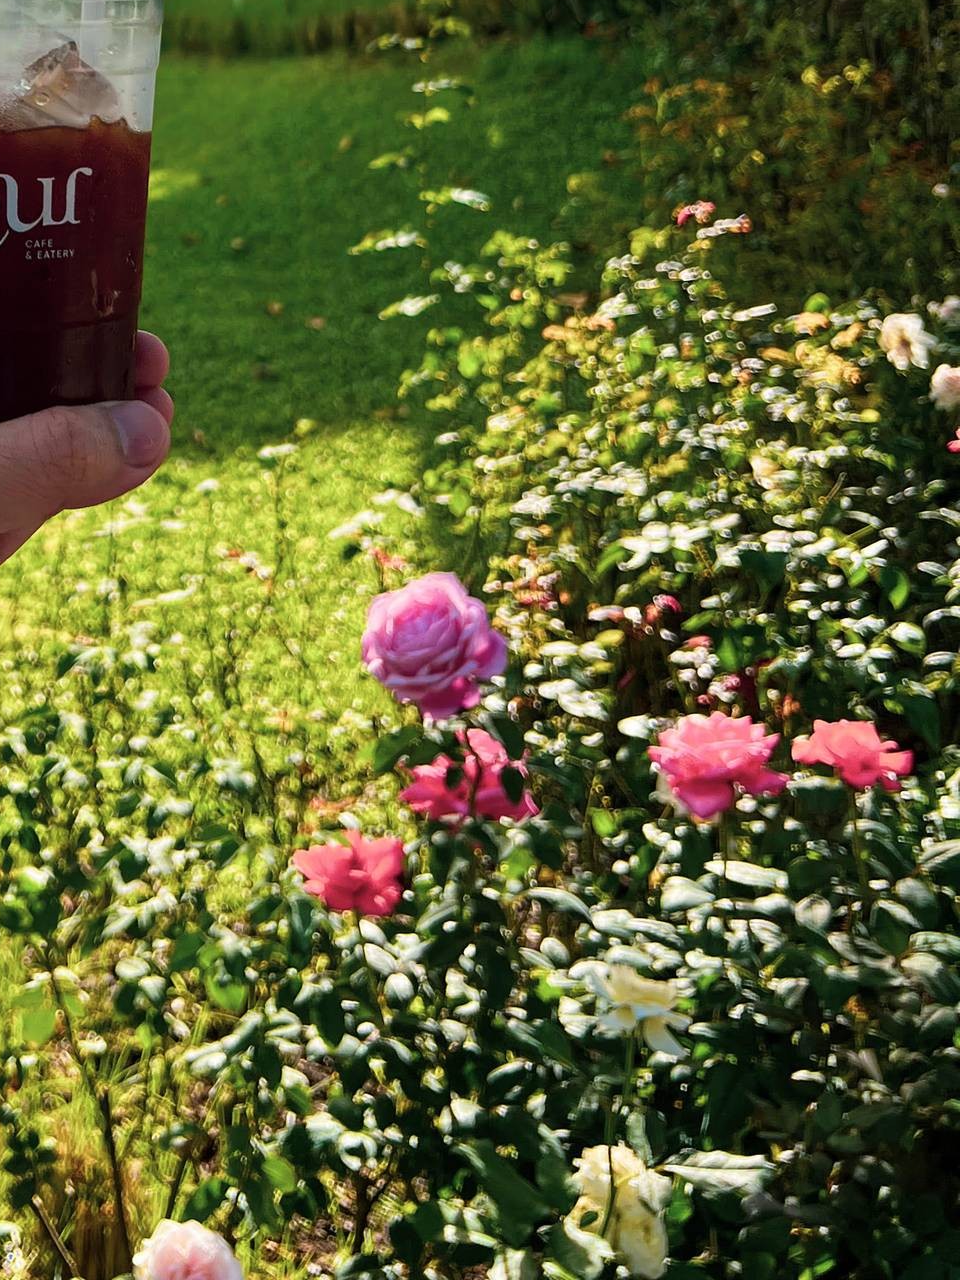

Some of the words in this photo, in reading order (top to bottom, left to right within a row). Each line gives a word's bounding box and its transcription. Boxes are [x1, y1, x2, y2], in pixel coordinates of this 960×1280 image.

[25, 239, 53, 248] CAFE
[25, 250, 32, 260] &
[37, 249, 74, 259] EATERY
